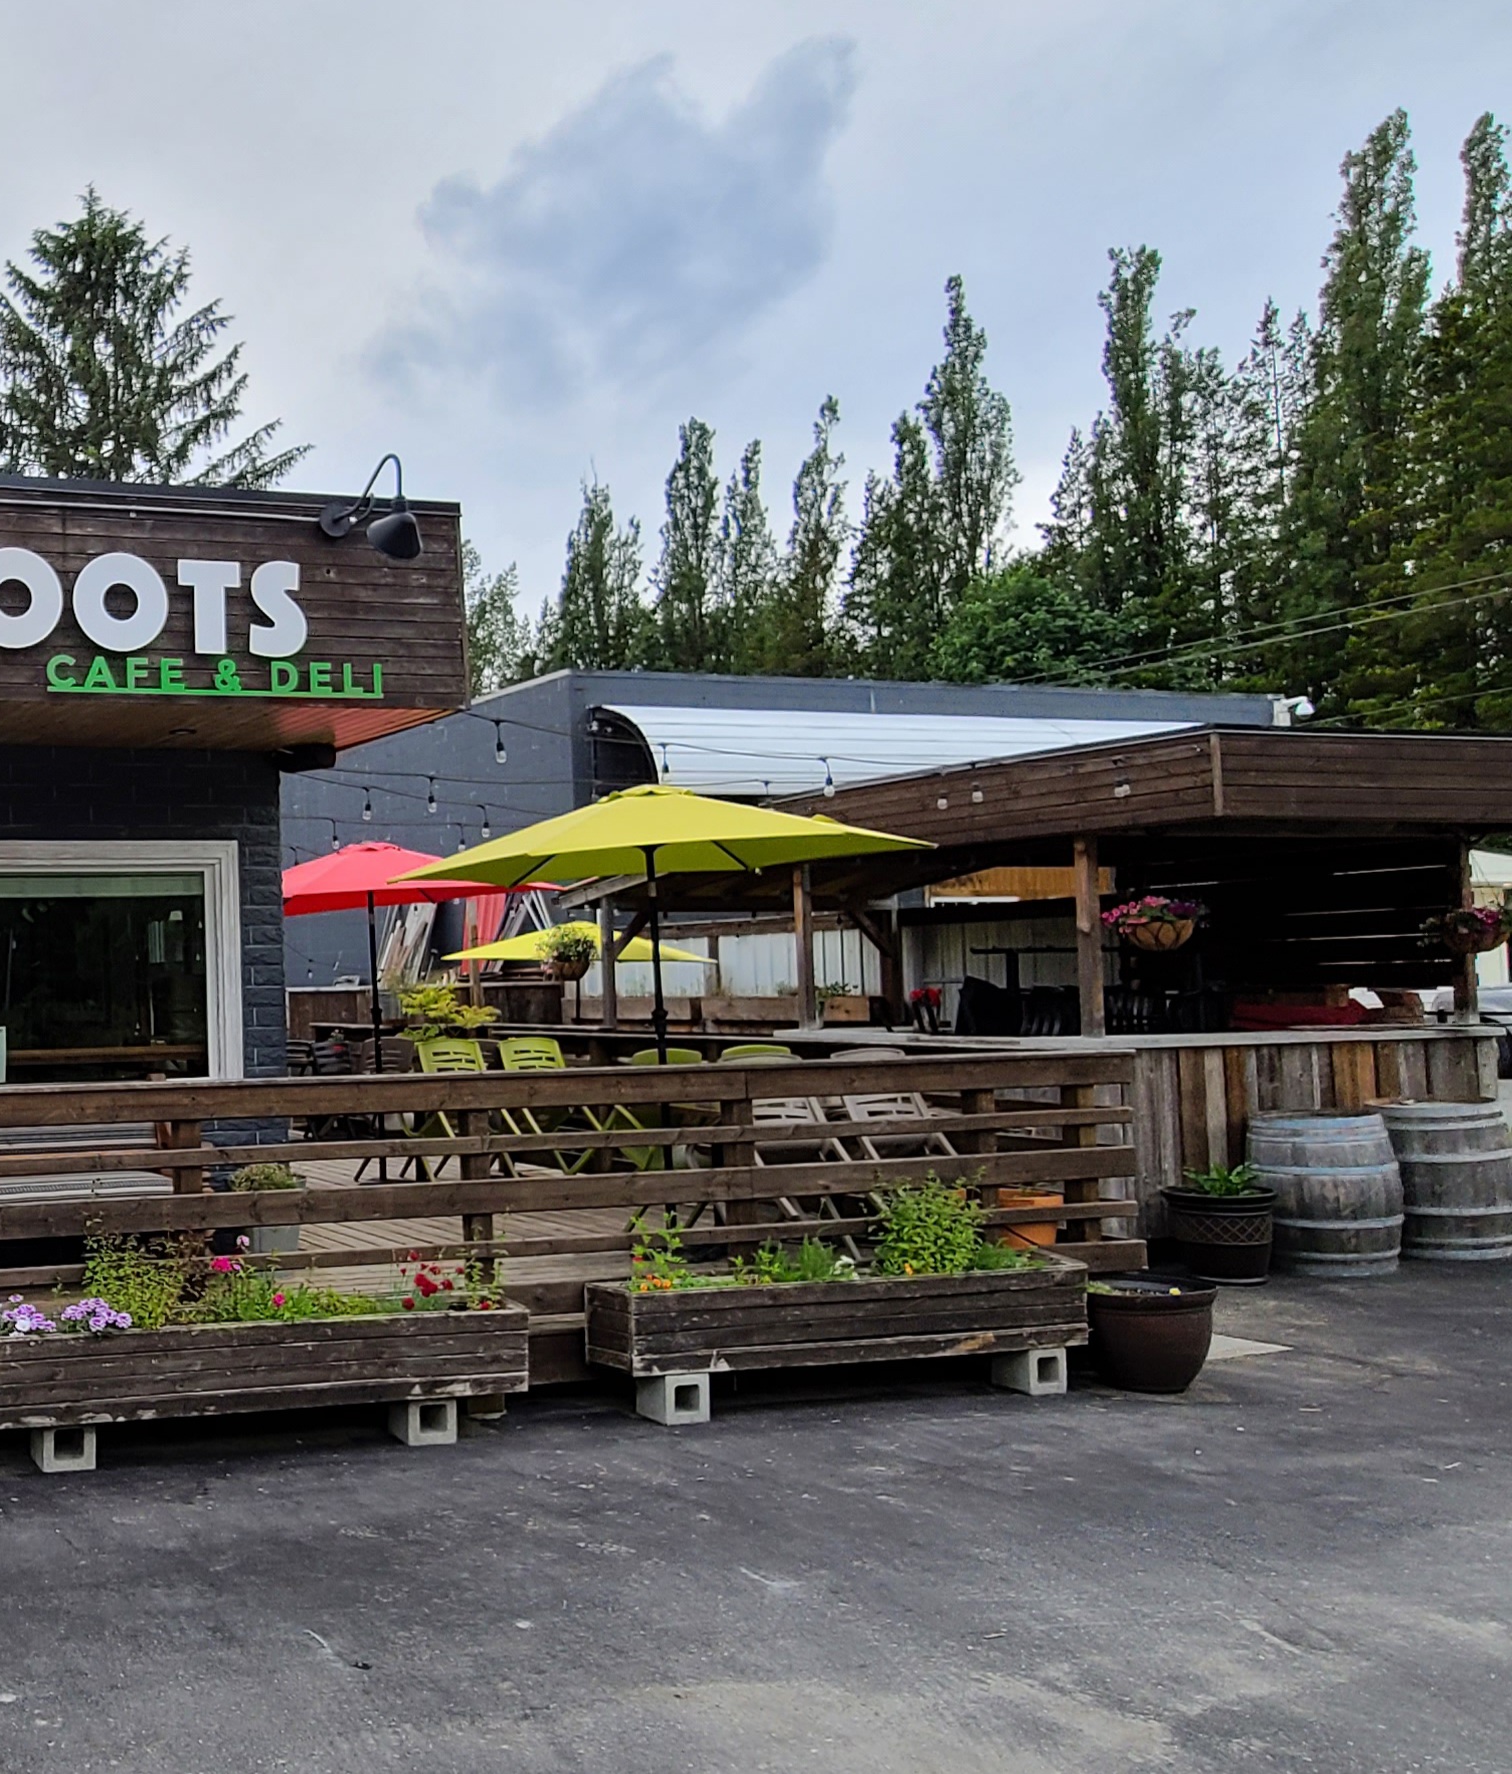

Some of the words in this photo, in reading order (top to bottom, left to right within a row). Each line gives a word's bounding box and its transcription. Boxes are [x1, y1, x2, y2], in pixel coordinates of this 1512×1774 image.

[46, 654, 186, 690] CAFE
[214, 659, 241, 692] &
[270, 661, 384, 697] DELI
